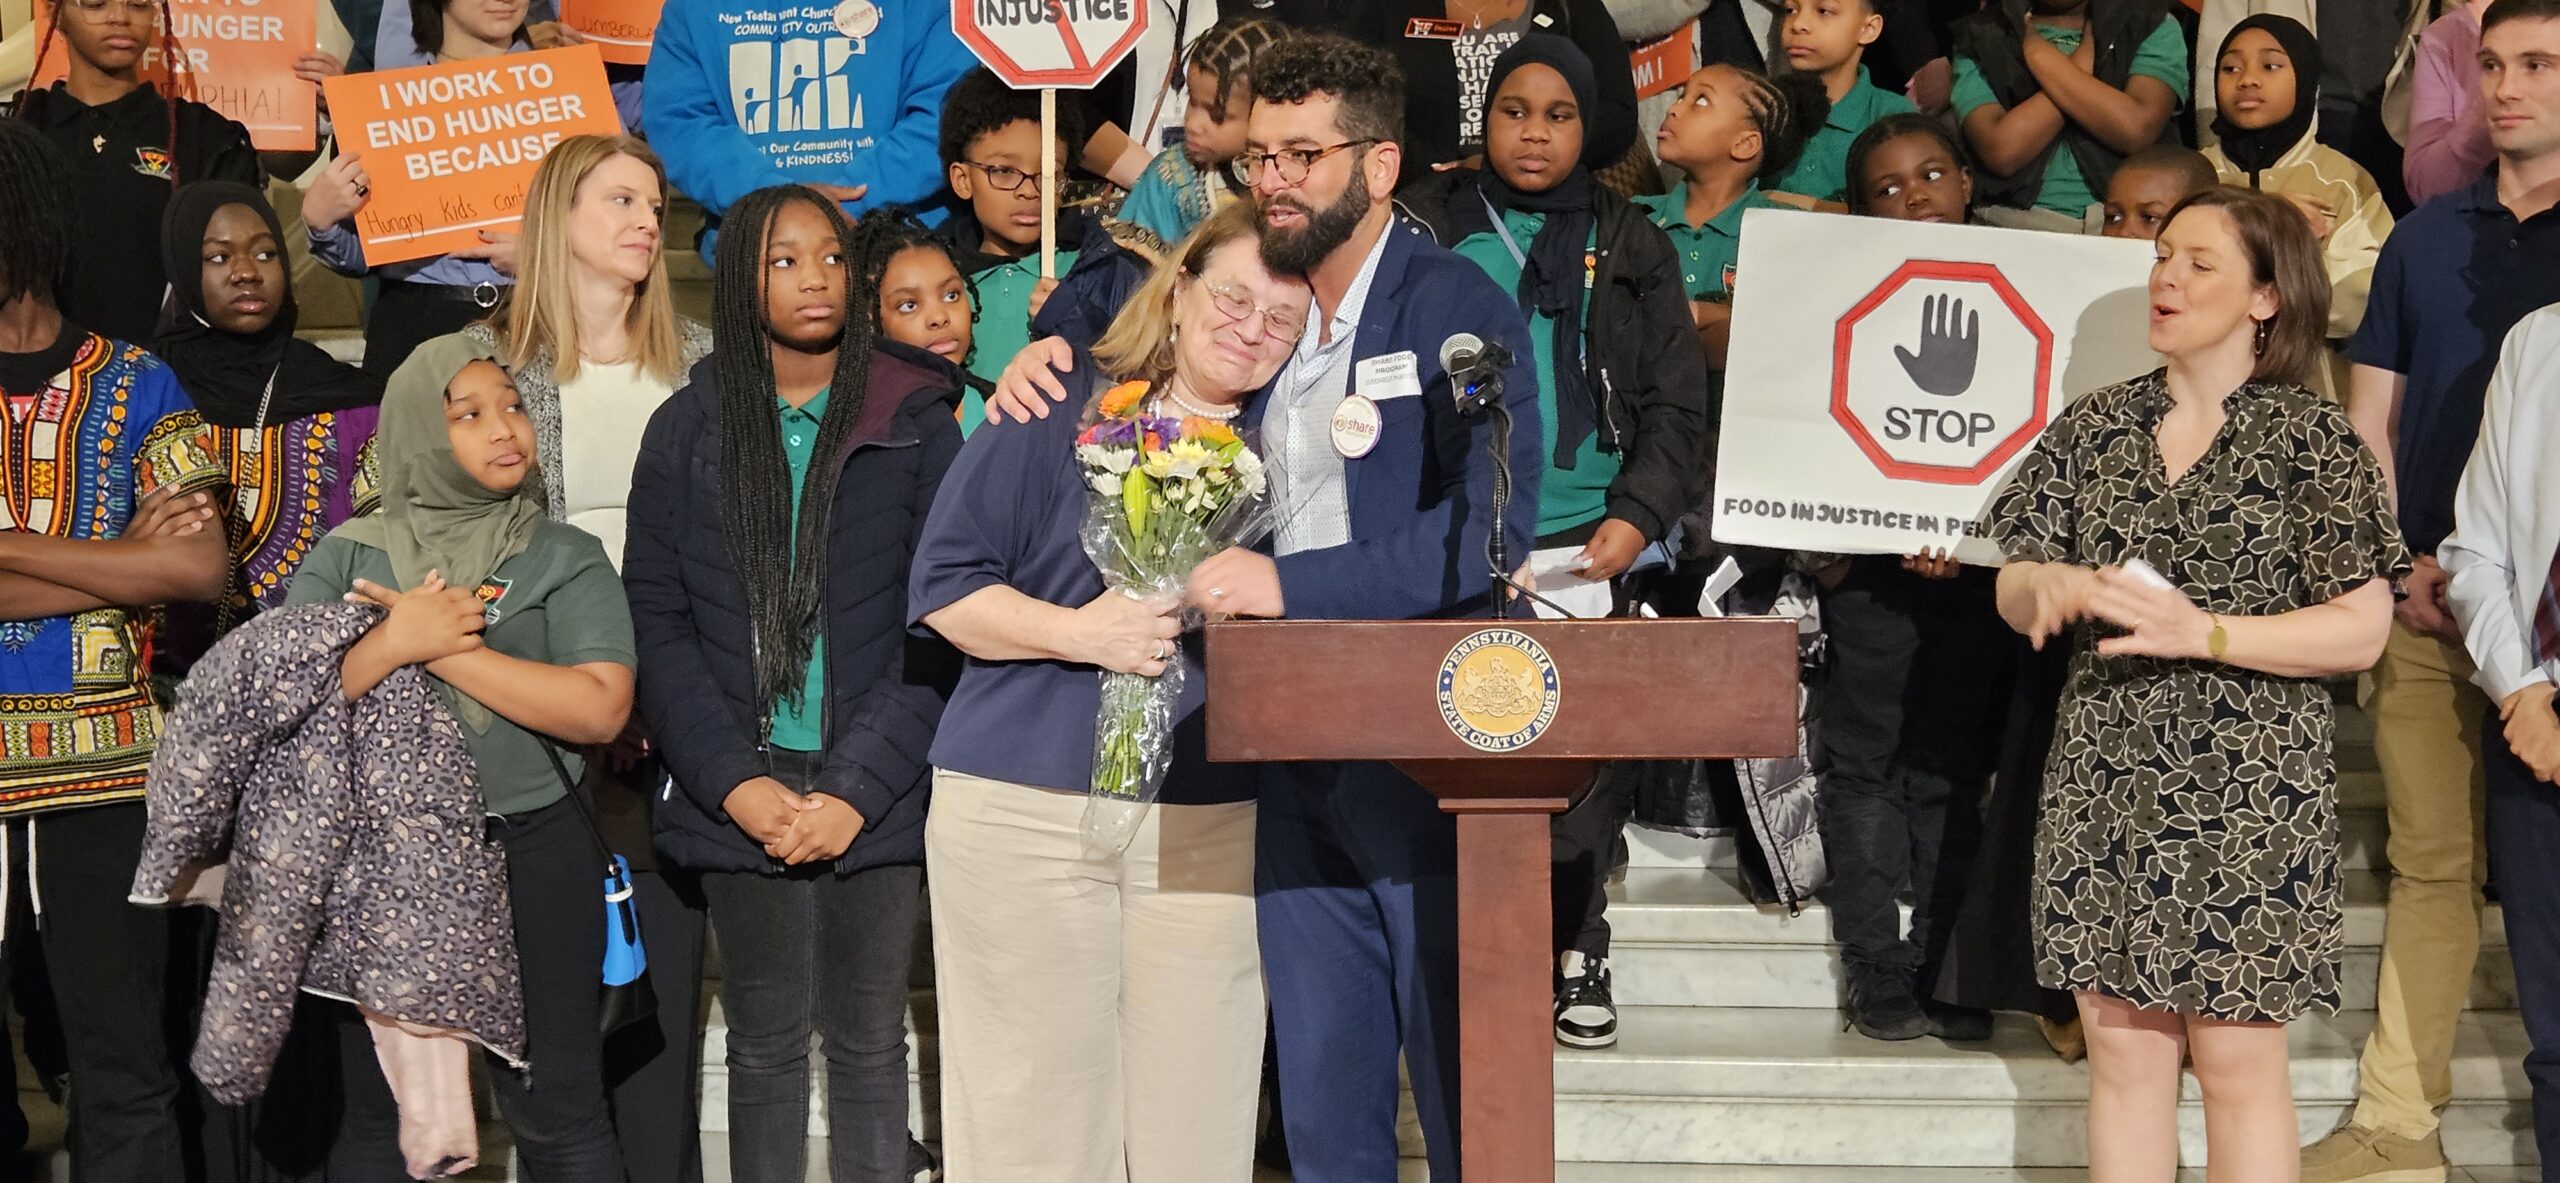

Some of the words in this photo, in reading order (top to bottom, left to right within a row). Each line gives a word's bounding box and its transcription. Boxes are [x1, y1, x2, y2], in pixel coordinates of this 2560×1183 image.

[719, 13, 742, 24] New
[978, 0, 1129, 26] INJUSTICE
[1482, 32, 1520, 44] ARE
[379, 84, 391, 110] I
[396, 69, 504, 108] WORK
[507, 63, 554, 91] TO
[366, 115, 436, 149] END
[444, 94, 586, 138] HUNGER
[405, 132, 561, 180] BECAUSE
[770, 143, 790, 153] Our
[793, 138, 853, 151] Community
[856, 136, 874, 148] with
[365, 211, 424, 242] Hungry
[1347, 418, 1375, 435] share
[1884, 407, 1995, 447] STOP
[1723, 498, 1786, 519] FOOD
[1791, 503, 1912, 531] INJUSTICE
[1916, 516, 1939, 534] IN
[1444, 632, 1551, 674] PENNSYLVANIA
[1441, 690, 1471, 737] STATE
[1469, 732, 1511, 748] COAT
[1512, 727, 1533, 744] OF
[1532, 690, 1557, 733] ARMS
